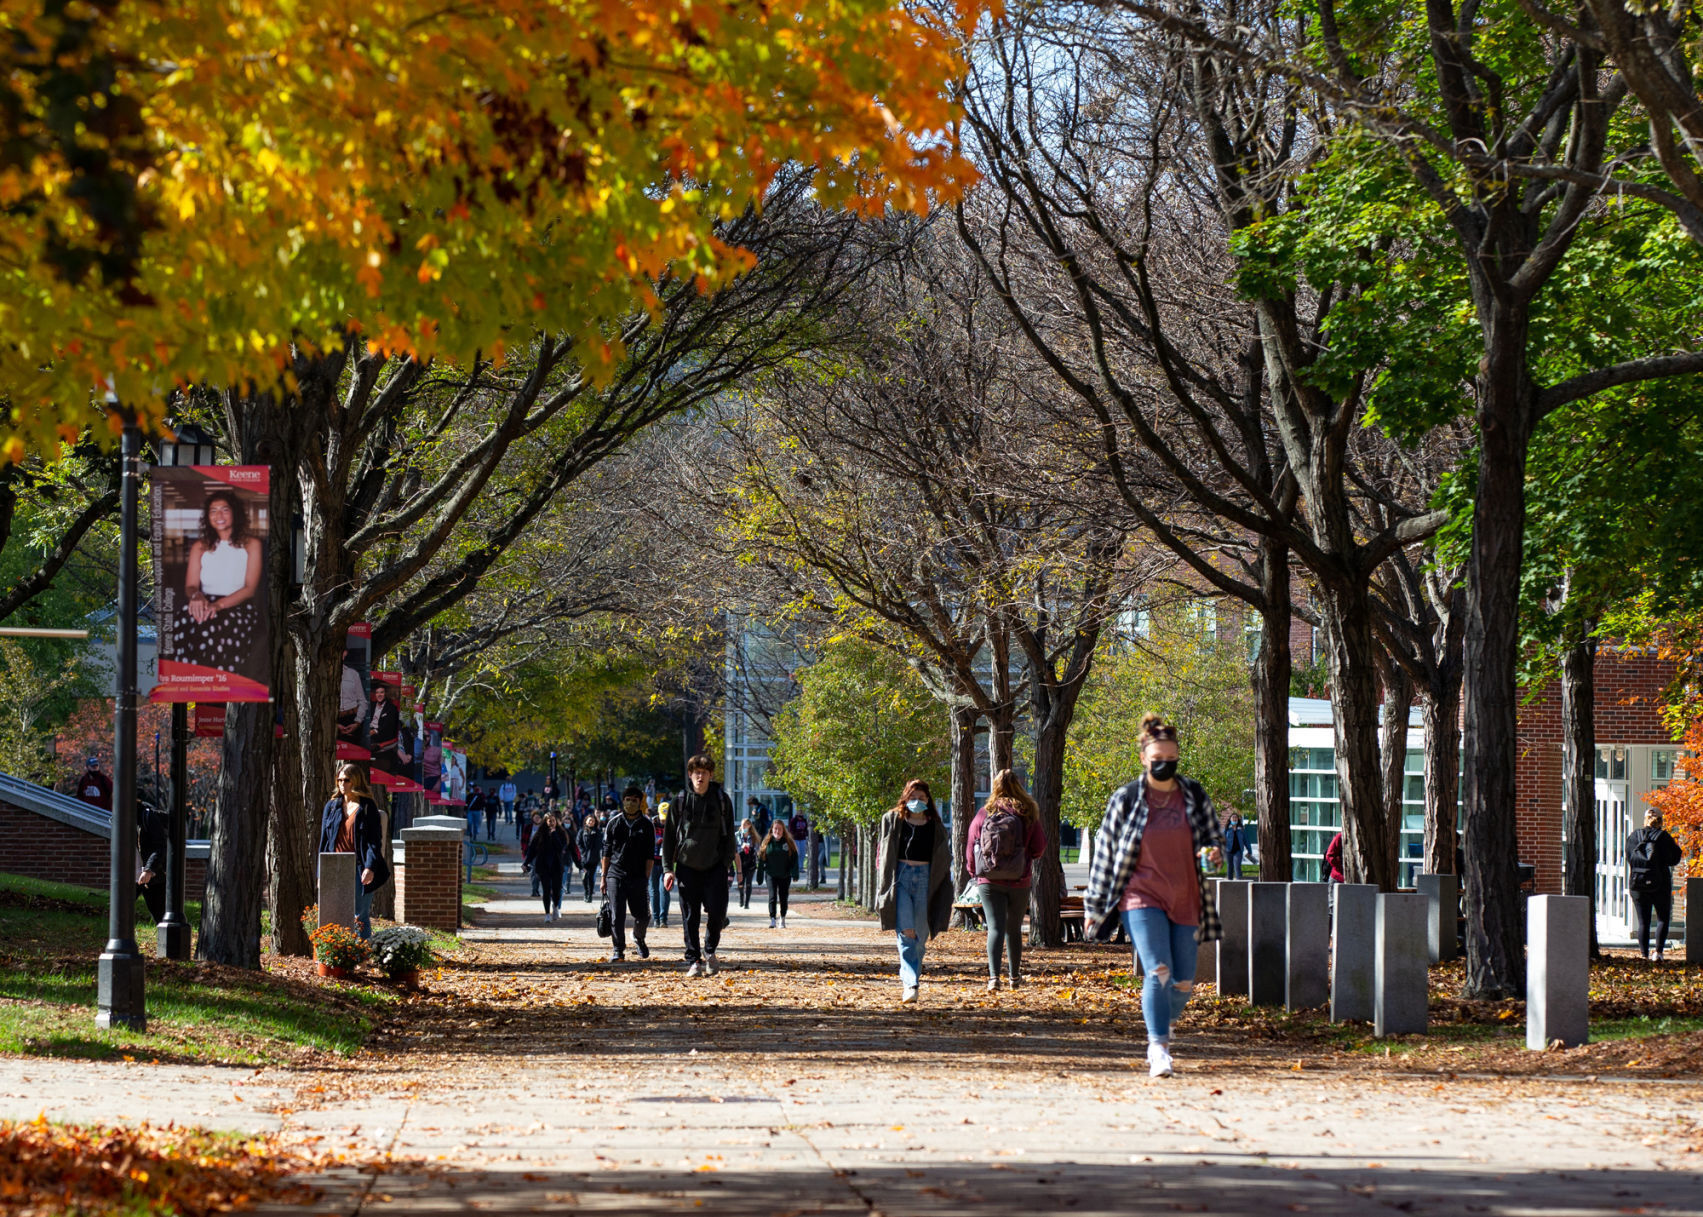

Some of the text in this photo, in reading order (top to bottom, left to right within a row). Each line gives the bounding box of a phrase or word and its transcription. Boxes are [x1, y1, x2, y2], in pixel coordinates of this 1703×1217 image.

[229, 470, 261, 479] Keene
[152, 520, 163, 542] Equity
[153, 543, 162, 556] and
[163, 588, 175, 612] College
[163, 613, 173, 632] State
